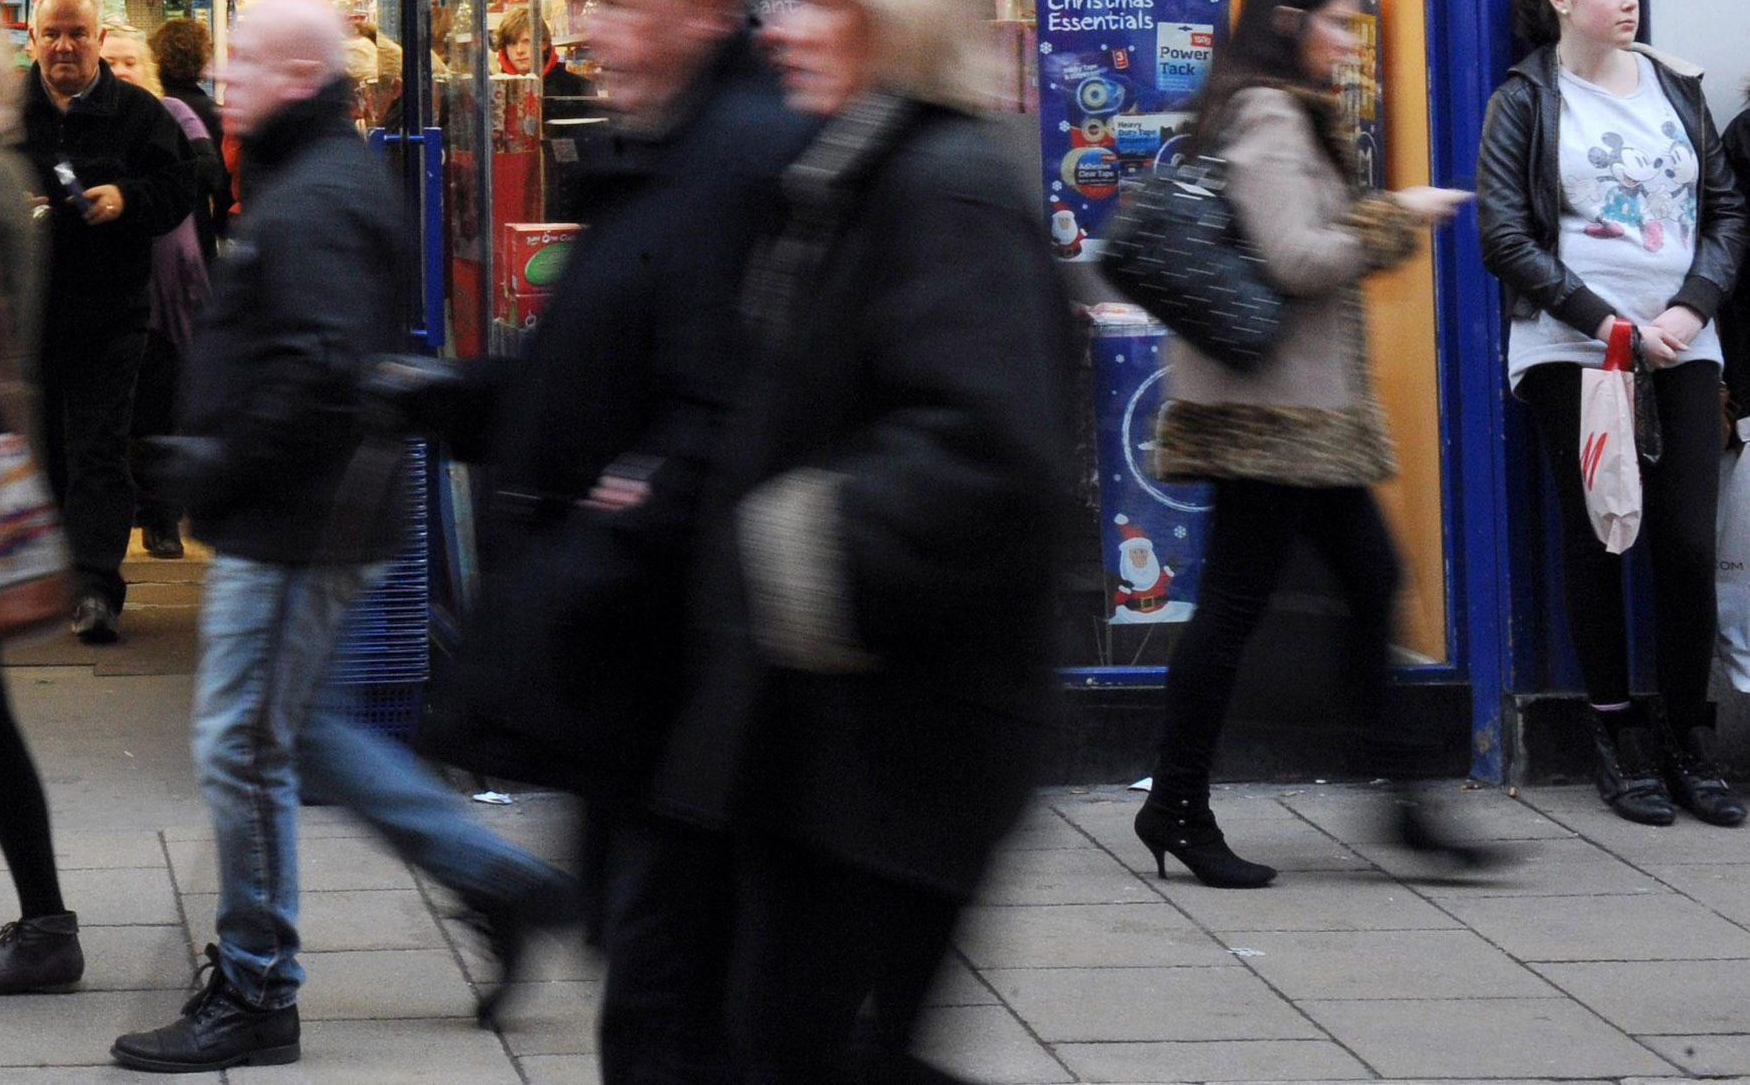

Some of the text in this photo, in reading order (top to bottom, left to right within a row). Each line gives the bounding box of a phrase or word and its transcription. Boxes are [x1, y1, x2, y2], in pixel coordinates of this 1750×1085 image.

[1048, 12, 1154, 32] Essentials
[1160, 46, 1210, 60] Power
[1159, 61, 1195, 75] Tack
